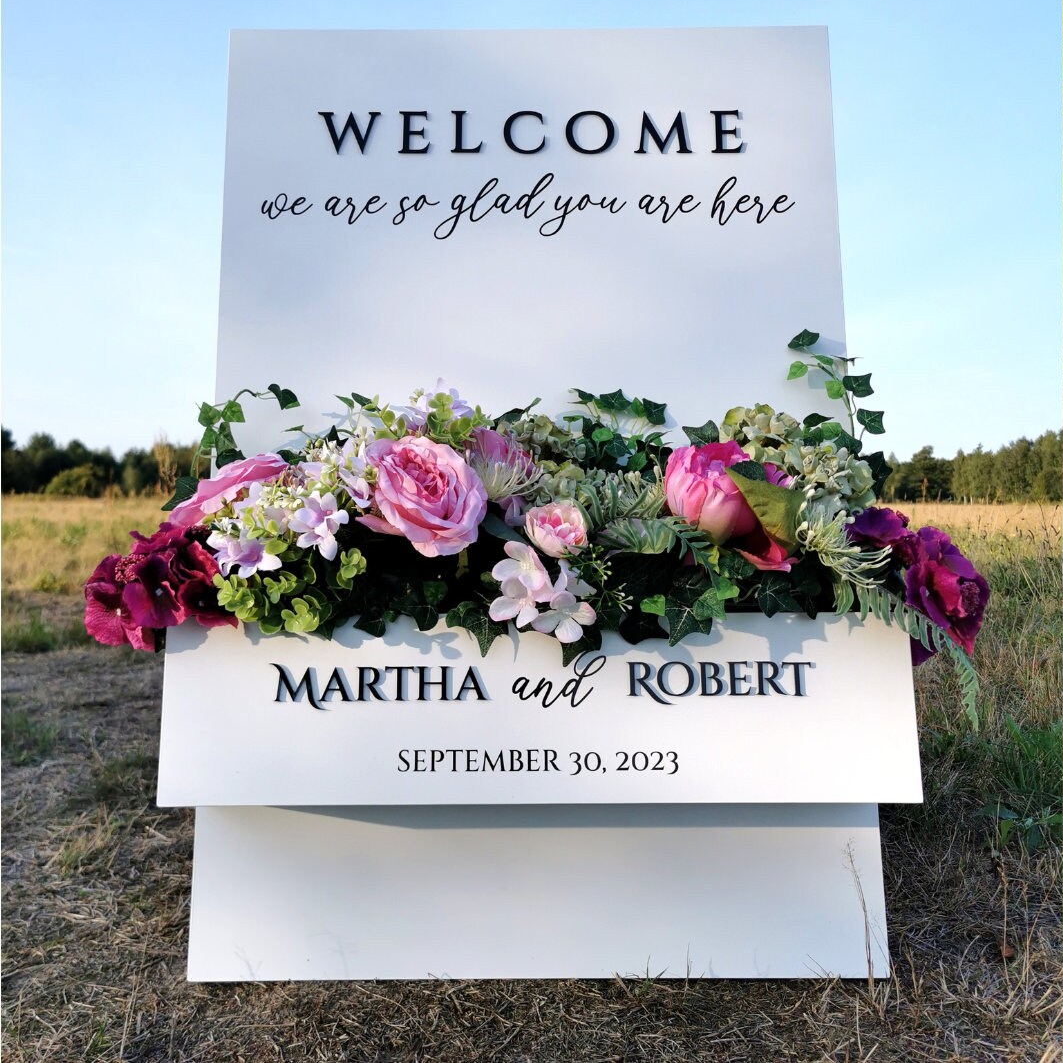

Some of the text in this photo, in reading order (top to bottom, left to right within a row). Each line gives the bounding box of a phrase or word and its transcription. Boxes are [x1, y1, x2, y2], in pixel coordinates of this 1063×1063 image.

[317, 109, 744, 155] WELCOME
[260, 172, 796, 240] we are so glad you are here
[271, 654, 812, 710] MARTHA and ROBERT
[397, 749, 679, 776] SEPTEMBER 30, 2023
